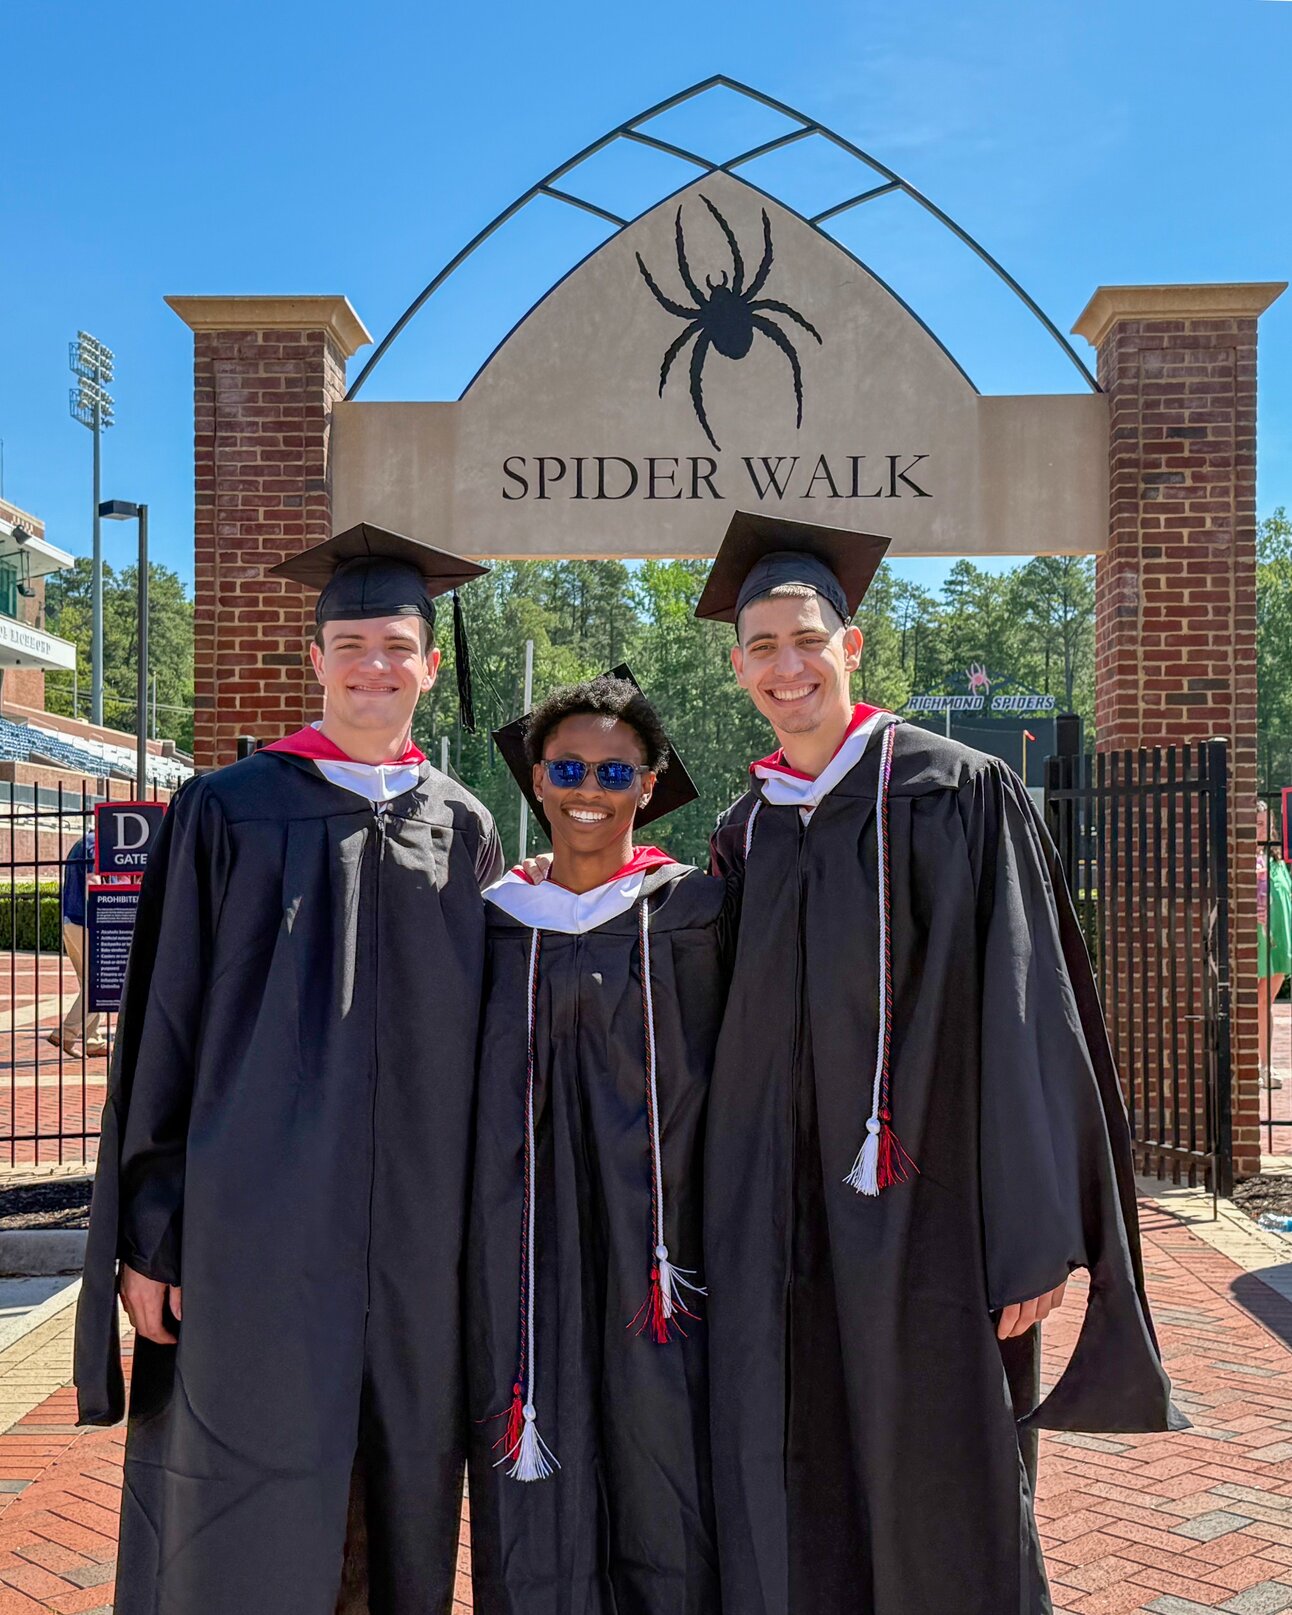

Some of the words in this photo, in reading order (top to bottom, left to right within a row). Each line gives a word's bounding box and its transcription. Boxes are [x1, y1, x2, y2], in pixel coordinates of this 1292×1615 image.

[502, 456, 725, 500] SPIDER
[740, 454, 933, 500] WALK
[908, 696, 985, 710] RICHMOND
[991, 696, 1055, 710] SPIDERS
[112, 812, 150, 850] D
[114, 853, 148, 865] GATE
